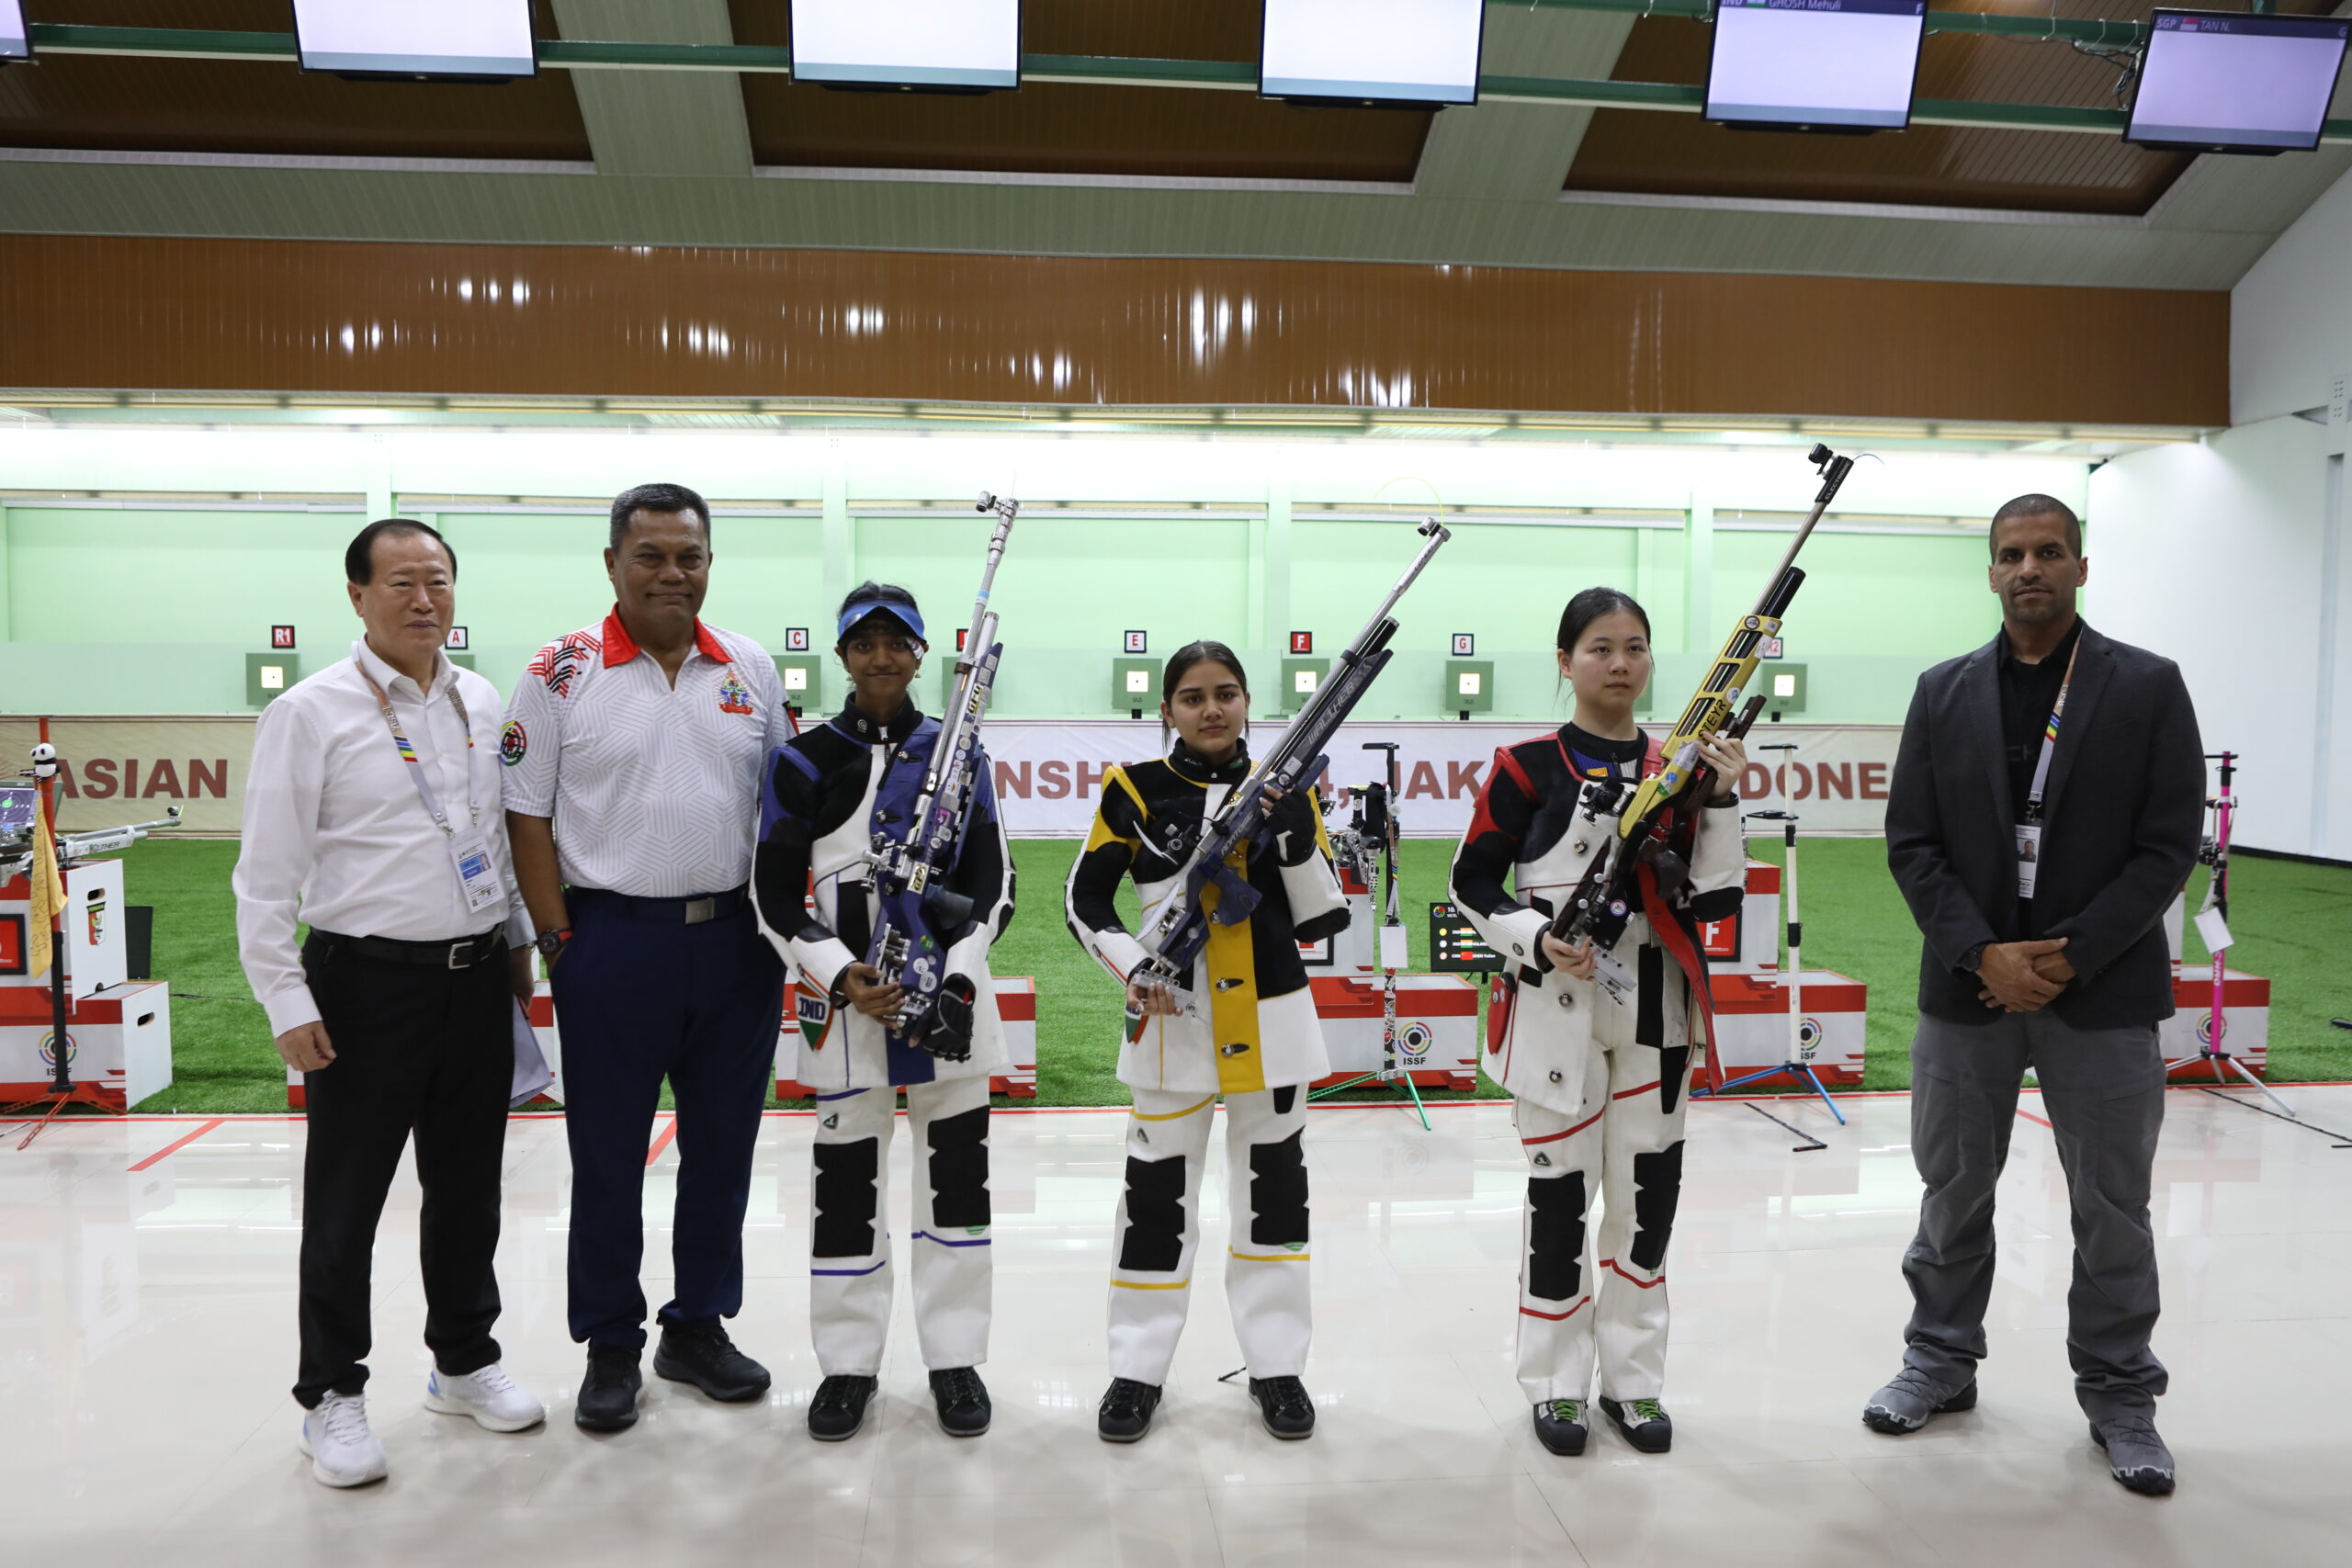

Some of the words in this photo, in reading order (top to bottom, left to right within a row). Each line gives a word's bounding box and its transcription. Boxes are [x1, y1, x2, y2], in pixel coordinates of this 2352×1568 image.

[1769, 0, 1806, 9] GHOSH
[1807, 0, 1841, 10] Mehuli
[1916, 5, 1923, 15] F
[2156, 18, 2177, 29] SGP
[2200, 20, 2219, 30] TAN
[2221, 22, 2231, 31] N.
[275, 627, 291, 643] R1
[452, 631, 459, 643] A
[793, 631, 801, 645] C
[1131, 635, 1138, 647] E
[1297, 635, 1305, 649] F
[1459, 637, 1466, 649] G
[1307, 682, 1356, 745] WALTHER
[995, 761, 1133, 799] NSH
[1705, 920, 1721, 946] F
[797, 997, 826, 1021] IND
[1403, 1057, 1426, 1066] ISSF
